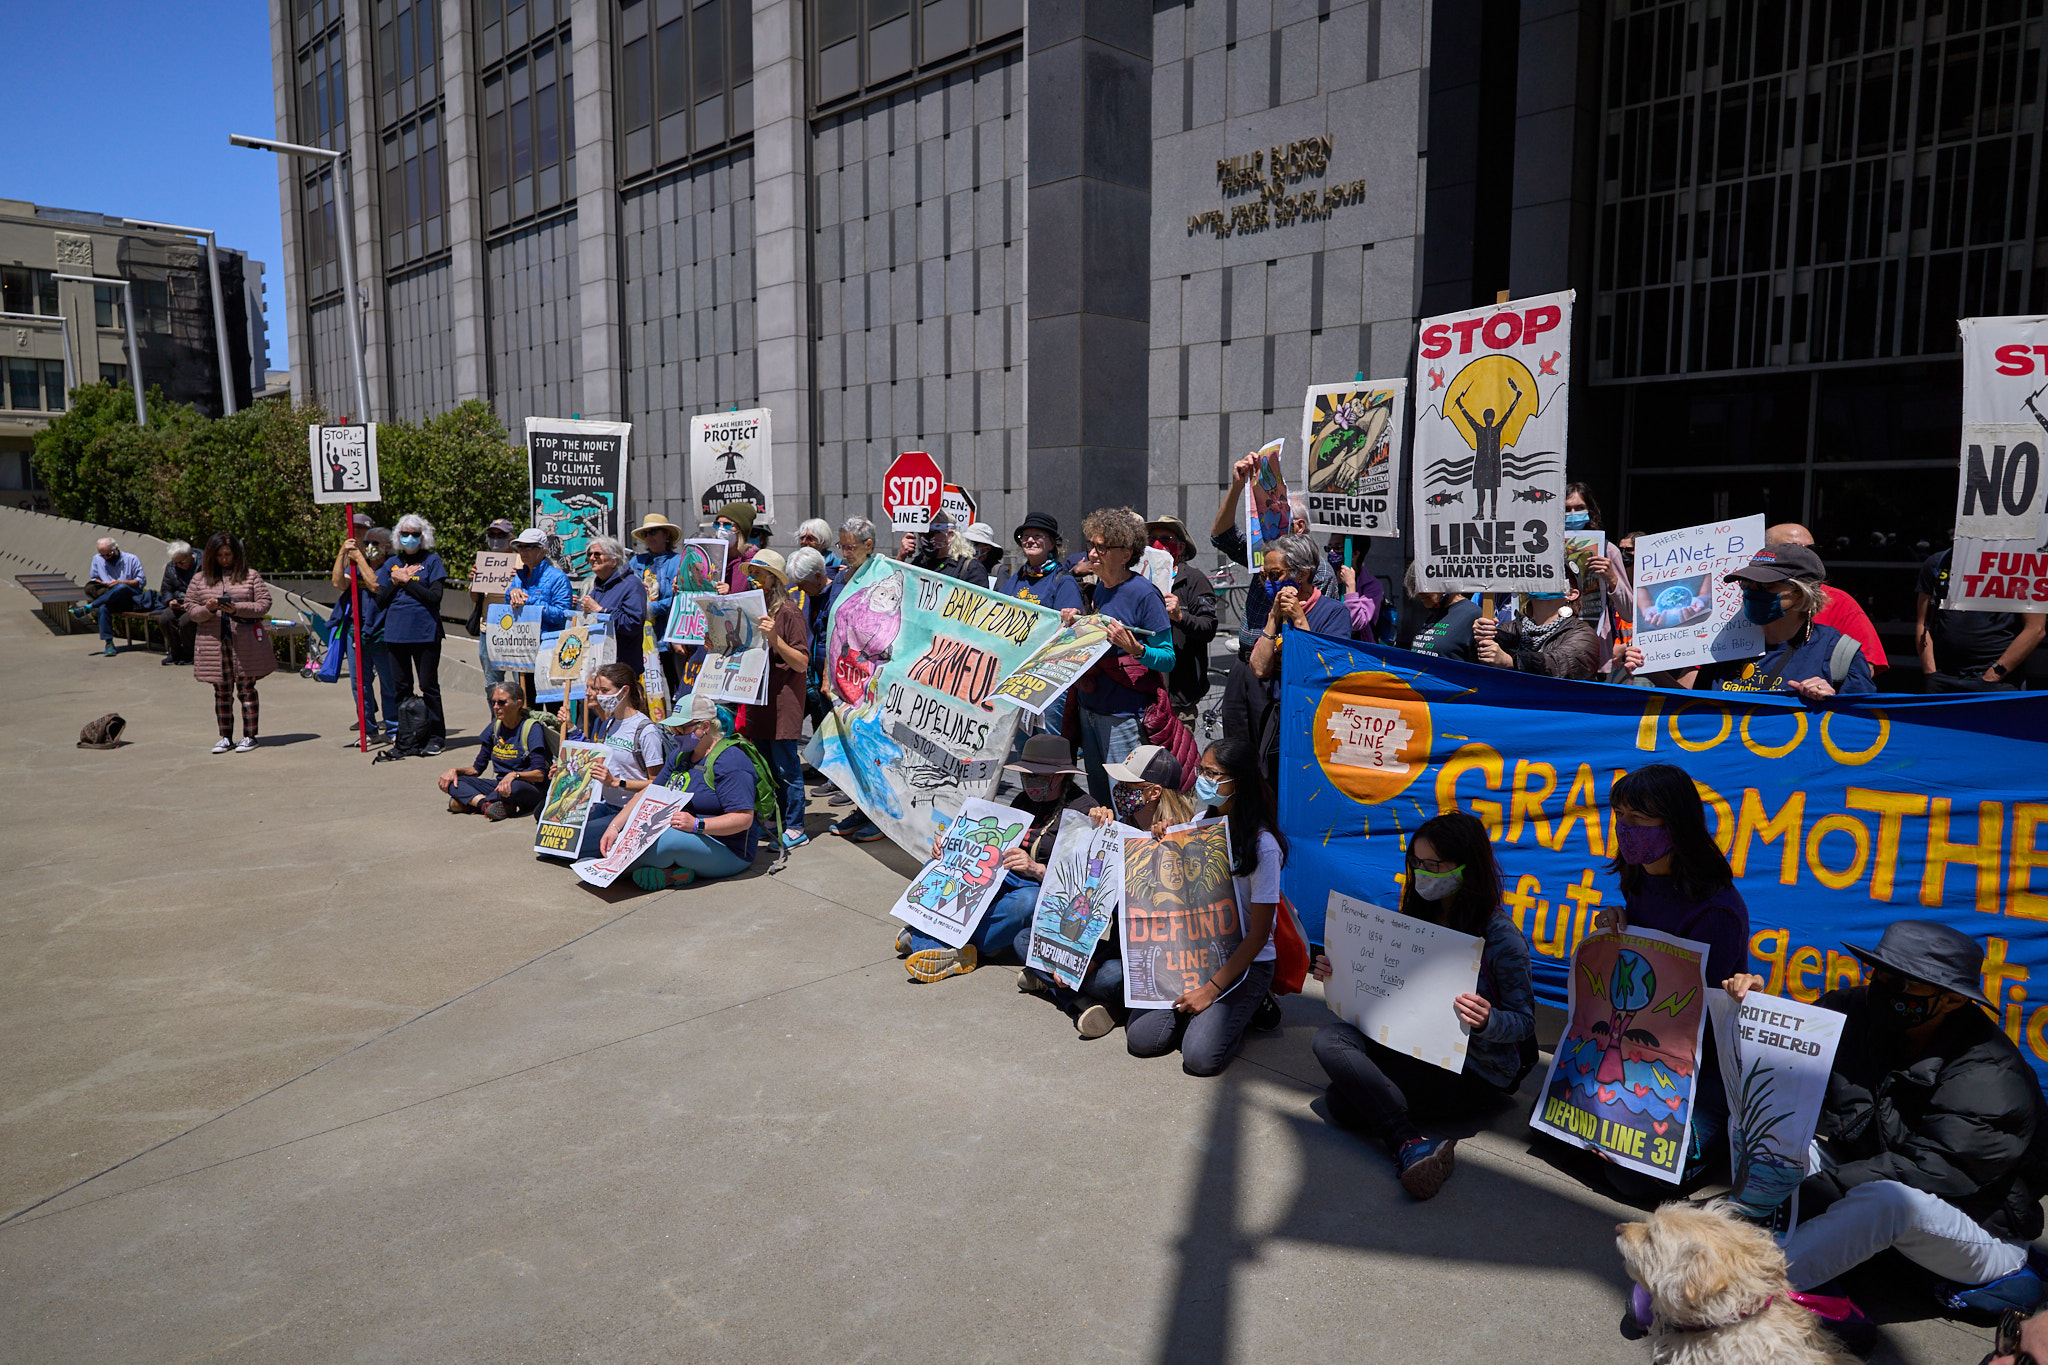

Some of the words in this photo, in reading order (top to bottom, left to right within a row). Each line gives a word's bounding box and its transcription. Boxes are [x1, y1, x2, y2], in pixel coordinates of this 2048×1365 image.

[1217, 150, 1264, 176] PHILLIP
[1271, 133, 1334, 164] BURTON
[1222, 167, 1264, 189] FEDERAL
[1272, 154, 1327, 179] BUILDING
[1261, 182, 1285, 199] AND
[1187, 210, 1223, 229] UNITED
[1231, 200, 1269, 219] STATES
[1274, 190, 1317, 210] COURT
[1323, 179, 1366, 202] HOUSE
[1420, 304, 1561, 360] STOP
[731, 420, 744, 428] HERE
[324, 429, 349, 440] STOP
[704, 426, 758, 442] PROTECT
[341, 447, 362, 457] LINE
[535, 437, 558, 449] STOP
[562, 439, 580, 450] THE
[583, 441, 616, 453] MONEY
[552, 450, 595, 463] PIPELINE
[351, 461, 360, 476] 3
[545, 462, 558, 473] TO
[561, 463, 602, 475] CLIMATE
[541, 473, 605, 487] DESTRUCTION
[1360, 475, 1387, 484] MONEY
[1962, 441, 2040, 517] NO
[715, 483, 746, 493] WATER
[888, 475, 938, 506] STOP
[1358, 484, 1388, 493] PIPELINE
[1309, 496, 1387, 513] DEFUND
[893, 512, 918, 523] LINE
[920, 508, 930, 524] 3
[1319, 512, 1362, 528] LINE
[1365, 514, 1378, 529] 3
[1430, 520, 1516, 556] LINE
[1522, 519, 1550, 555] 3
[1651, 532, 1685, 549] THERE
[1695, 527, 1704, 535] IS
[1714, 525, 1731, 535] NO
[1727, 536, 1745, 554] B
[484, 556, 508, 567] End
[1441, 555, 1460, 564] TAR
[1461, 556, 1492, 564] SANDS
[1493, 554, 1536, 564] PIPELINE
[1425, 565, 1493, 579] CLIMATE
[1499, 564, 1554, 579] CRISIS
[1685, 565, 1695, 575] A
[1714, 568, 1730, 583] THE
[942, 587, 985, 627] BANK
[1639, 626, 1689, 646] EVIDENCE
[1674, 649, 1695, 658] Good
[1702, 639, 1727, 653] Public
[1732, 637, 1754, 649] Policy
[734, 675, 758, 684] DEFUND
[907, 635, 1000, 712] HARMFUL
[885, 683, 904, 716] OIL
[1020, 688, 1032, 700] 3
[1636, 695, 1890, 766] 1000
[1349, 730, 1385, 750] LINE
[913, 734, 936, 758] STOP
[941, 753, 970, 780] LINE
[979, 763, 987, 778] 3
[1373, 751, 1384, 767] 3
[540, 824, 574, 839] DEFUND
[540, 836, 559, 849] LINE
[560, 840, 567, 850] 3
[941, 836, 982, 858] DEFUND
[946, 856, 974, 871] LINE
[963, 844, 1002, 888] 3
[1128, 898, 1239, 943] DEFUND
[1341, 899, 1371, 920] Remember
[1375, 915, 1385, 926] the
[1415, 927, 1426, 936] of
[1368, 929, 1383, 943] 1854
[1411, 943, 1425, 955] 1855
[1637, 938, 1653, 949] OF
[1166, 949, 1209, 971] LINE
[1360, 947, 1375, 959] and
[1384, 953, 1400, 968] keep
[1544, 1096, 1598, 1141] DEFUND
[1600, 1119, 1648, 1159] LINE
[1651, 1136, 1677, 1168] 3!
